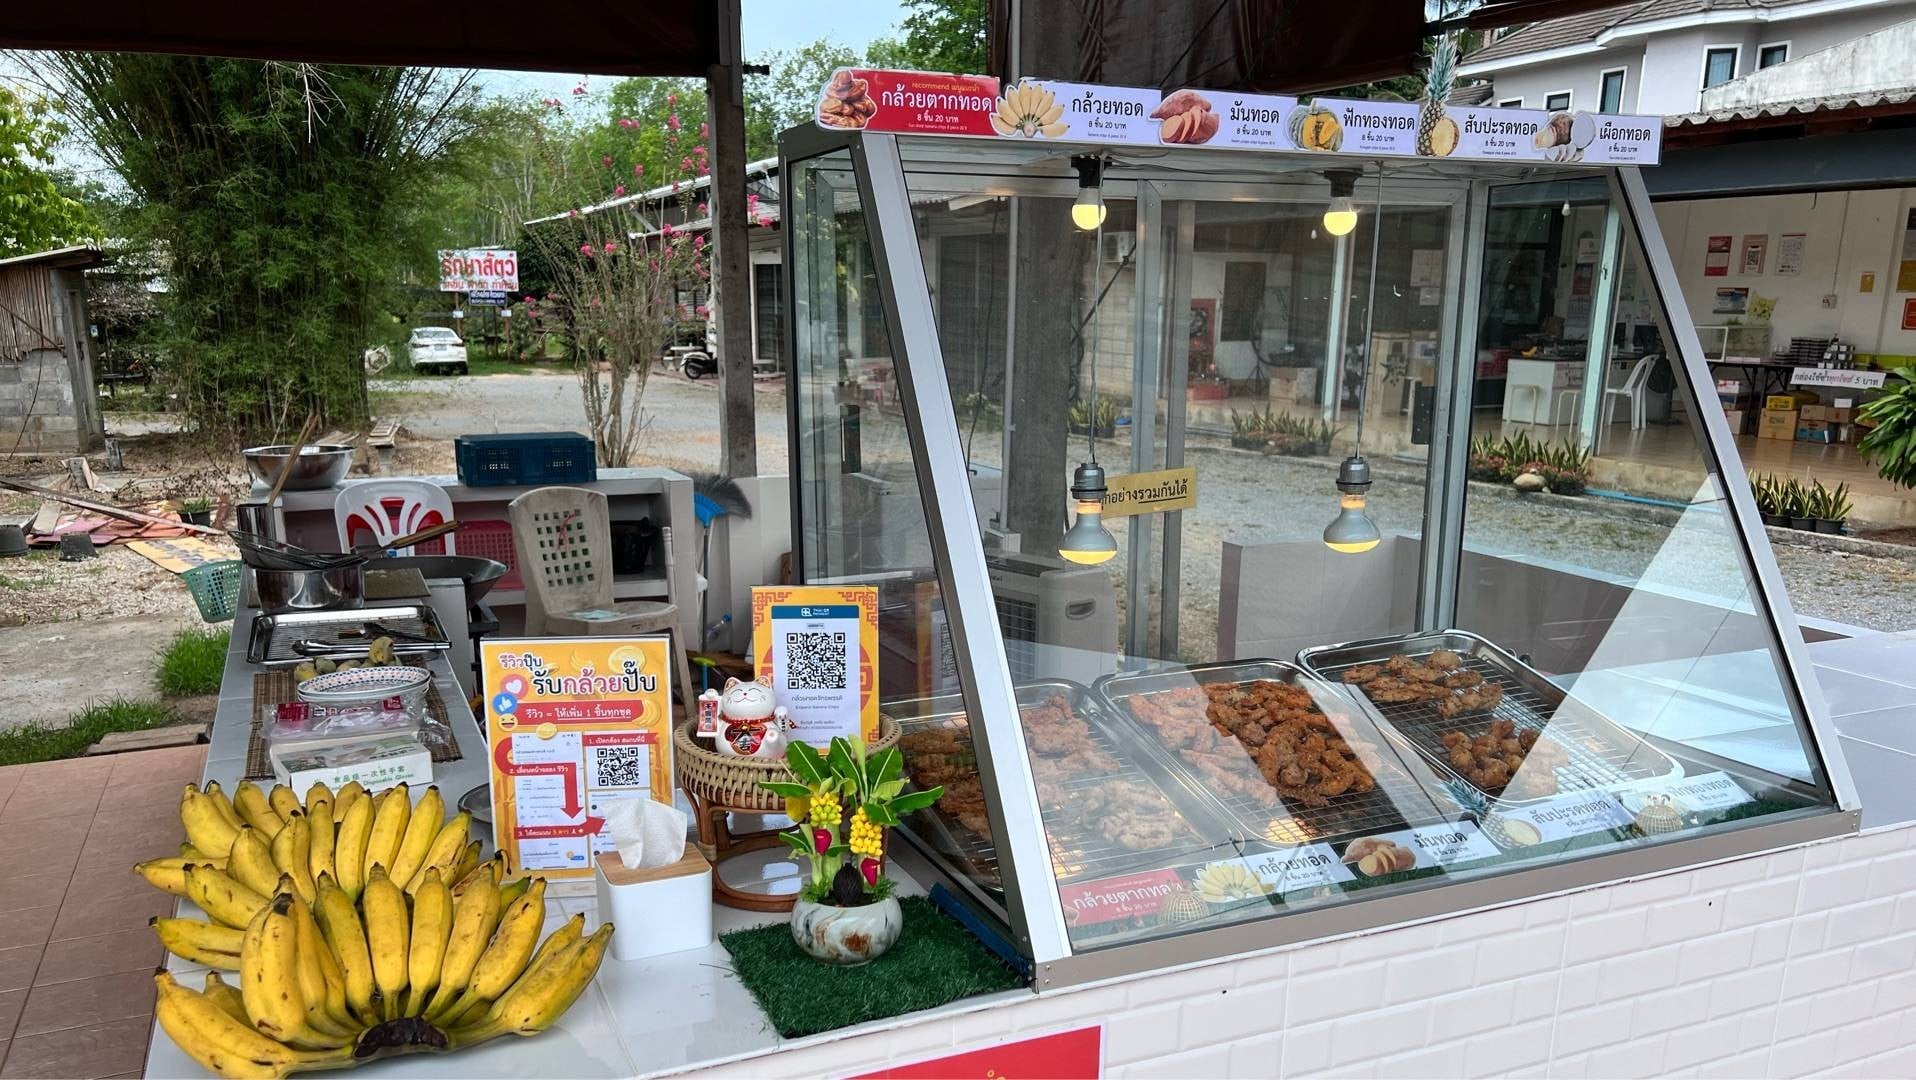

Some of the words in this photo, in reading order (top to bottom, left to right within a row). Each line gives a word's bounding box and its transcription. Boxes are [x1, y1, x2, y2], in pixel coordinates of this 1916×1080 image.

[912, 82, 949, 91] recommend
[882, 84, 992, 112] กล้วยตากทอด
[1072, 91, 1144, 116] กล้วยทอด
[924, 110, 934, 122] ชิ้น
[935, 114, 944, 122] 20
[946, 115, 958, 123] บาท
[1230, 100, 1280, 123] มันทอด
[1344, 107, 1414, 130] ฟักทองทอด
[1094, 117, 1103, 128] ชิ้น
[1114, 122, 1126, 130] บาท
[1242, 124, 1250, 134] ชิ้น
[1465, 114, 1538, 136] สับปะรดทอด
[1600, 122, 1650, 141] เผือกทอด
[442, 252, 515, 277] รักษาสัตว์
[1855, 376, 1860, 384] 5
[1863, 378, 1878, 386] บาท
[1102, 479, 1188, 506] กอย่างรวมกันได้
[533, 660, 656, 696] รับกล้วยปั๊บ
[526, 708, 544, 718] รีวิว
[556, 706, 582, 718] ให้เพิ่ม
[587, 709, 590, 717] 1
[594, 704, 632, 719] ชิ้นทุกชุด
[1530, 800, 1611, 824] สับปะรดทอด
[1414, 832, 1468, 848] มันทอด
[1259, 854, 1332, 875] กล้วยทอด
